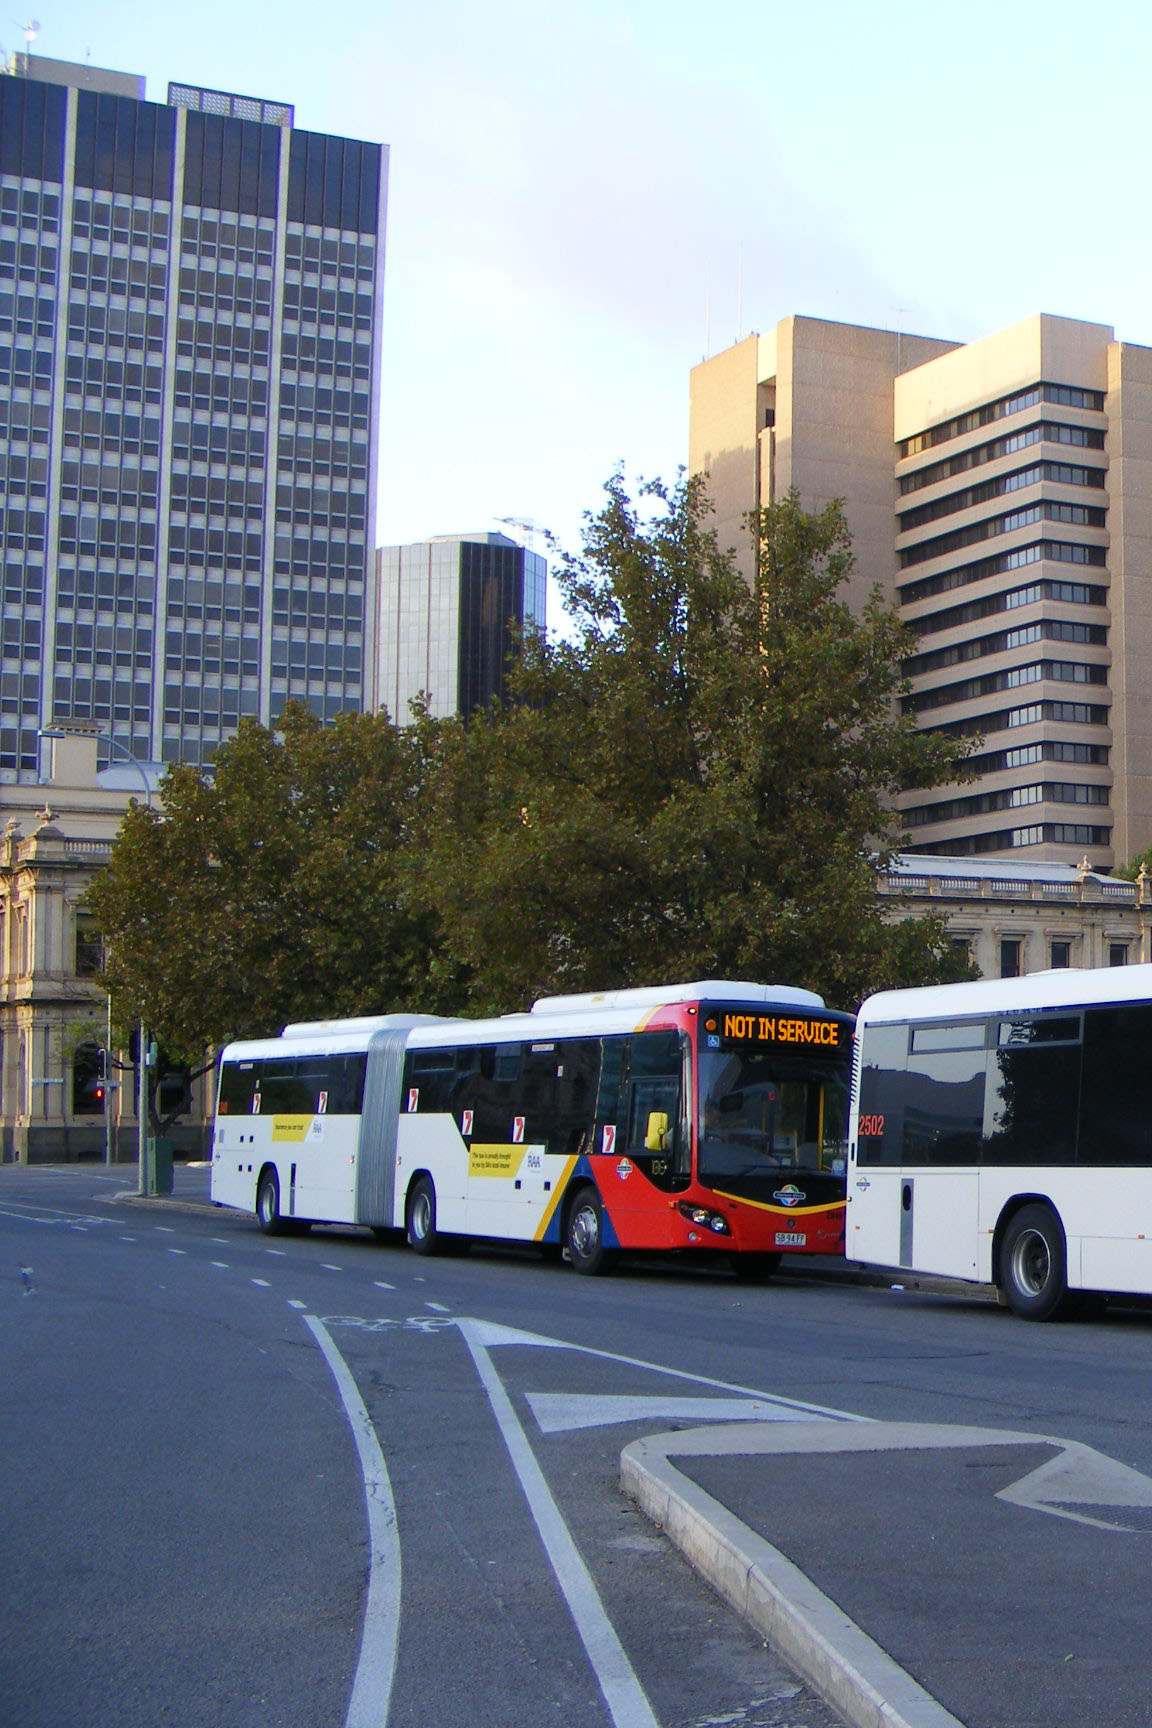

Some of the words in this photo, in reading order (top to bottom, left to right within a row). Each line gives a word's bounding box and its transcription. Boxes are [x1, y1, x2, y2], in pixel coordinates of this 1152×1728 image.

[725, 1014, 755, 1039] NOT
[758, 1017, 775, 1041] IN
[778, 1018, 839, 1045] SERVICE
[515, 1117, 523, 1142] 7
[858, 1115, 884, 1136] 2502
[605, 1126, 614, 1152] 7
[787, 1234, 795, 1242] 94
